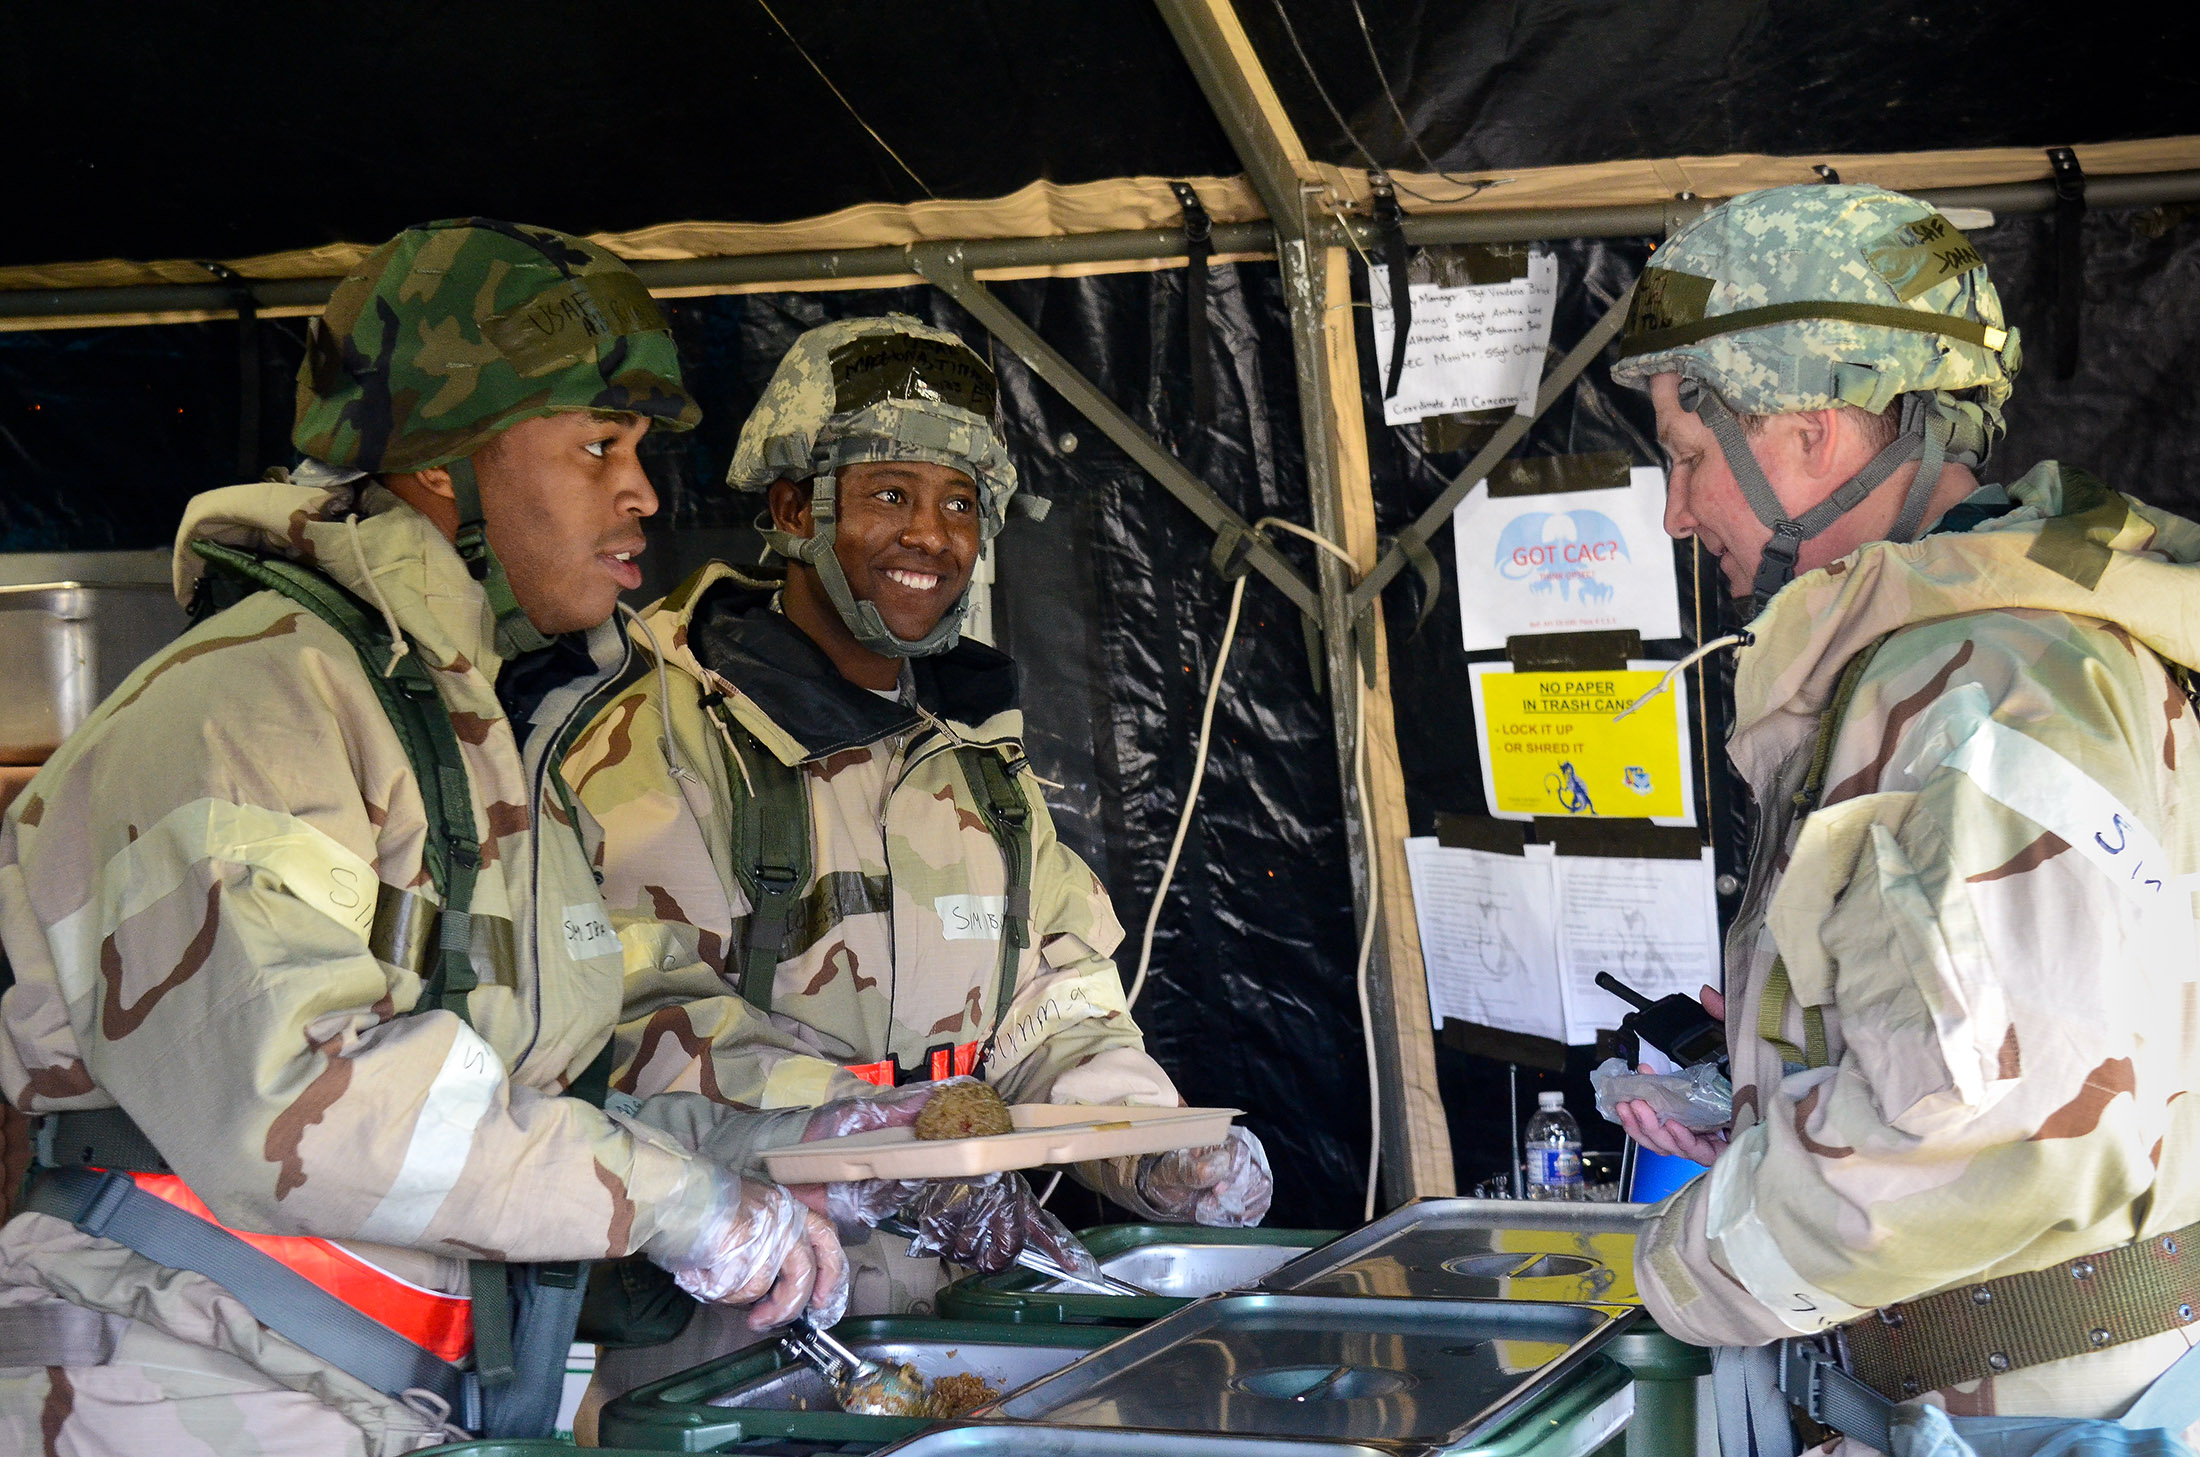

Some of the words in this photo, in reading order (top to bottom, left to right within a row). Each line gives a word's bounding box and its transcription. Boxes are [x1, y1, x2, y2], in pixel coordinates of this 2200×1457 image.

[528, 290, 588, 337] USAF
[1452, 397, 1468, 409] All
[1513, 545, 1557, 566] GOT
[1563, 540, 1618, 563] CAC?
[1540, 682, 1560, 694] NO
[1565, 682, 1614, 694] PAPER
[1523, 700, 1536, 710] IN
[1542, 699, 1590, 711] TRASH
[1595, 699, 1634, 711] CANS
[1503, 724, 1537, 735] LOCK
[1541, 724, 1551, 735] IT
[1556, 724, 1573, 735] UP
[1504, 742, 1522, 753] OR
[1527, 743, 1570, 754] SHRED
[1574, 743, 1584, 753] IT
